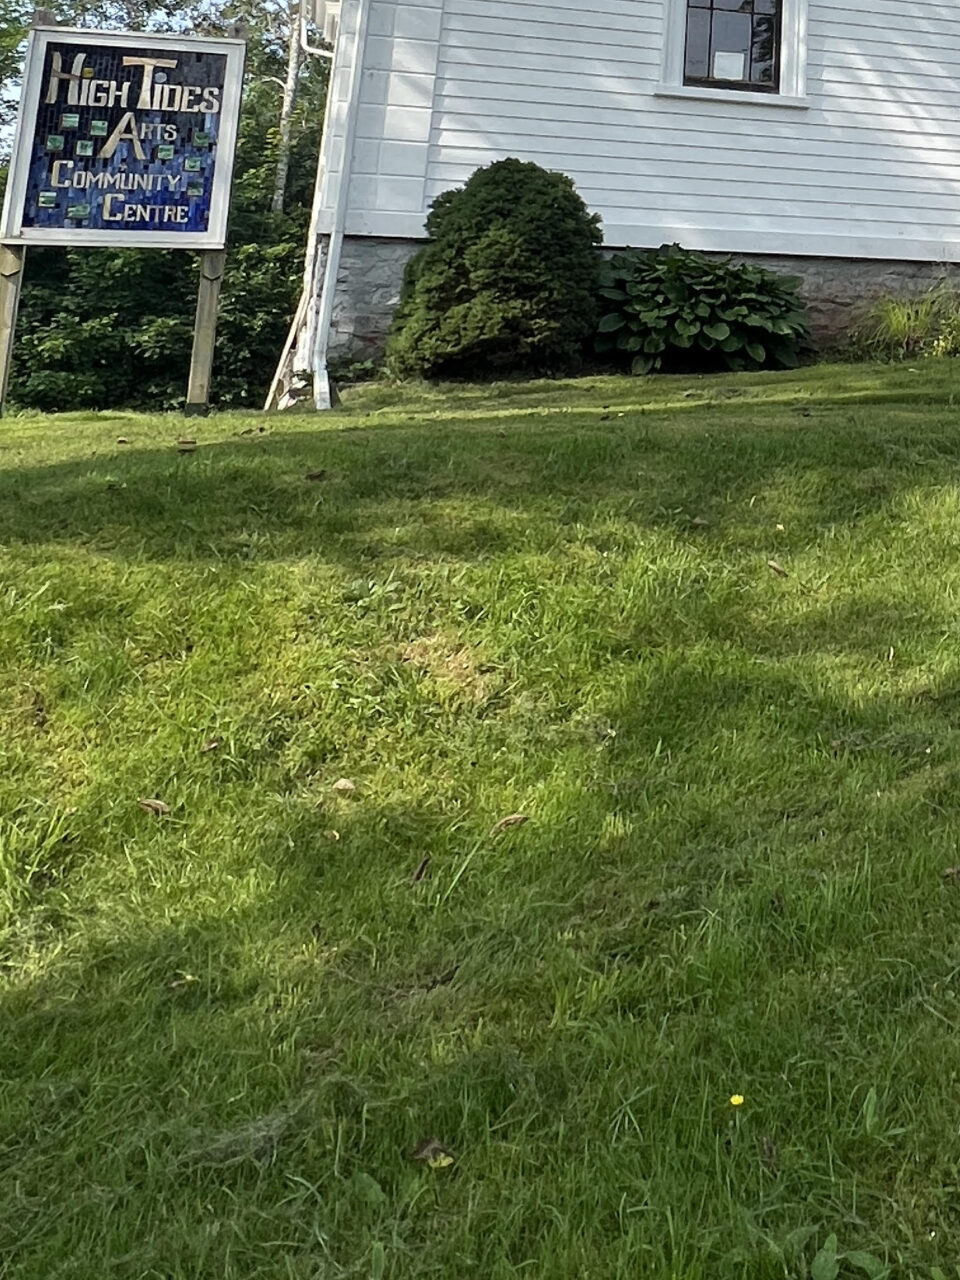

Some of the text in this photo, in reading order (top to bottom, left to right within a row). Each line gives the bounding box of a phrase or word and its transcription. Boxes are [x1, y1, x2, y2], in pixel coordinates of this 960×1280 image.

[97, 112, 178, 160] ARTS
[51, 160, 181, 191] COMMUNITY
[102, 193, 189, 223] CENTRE
